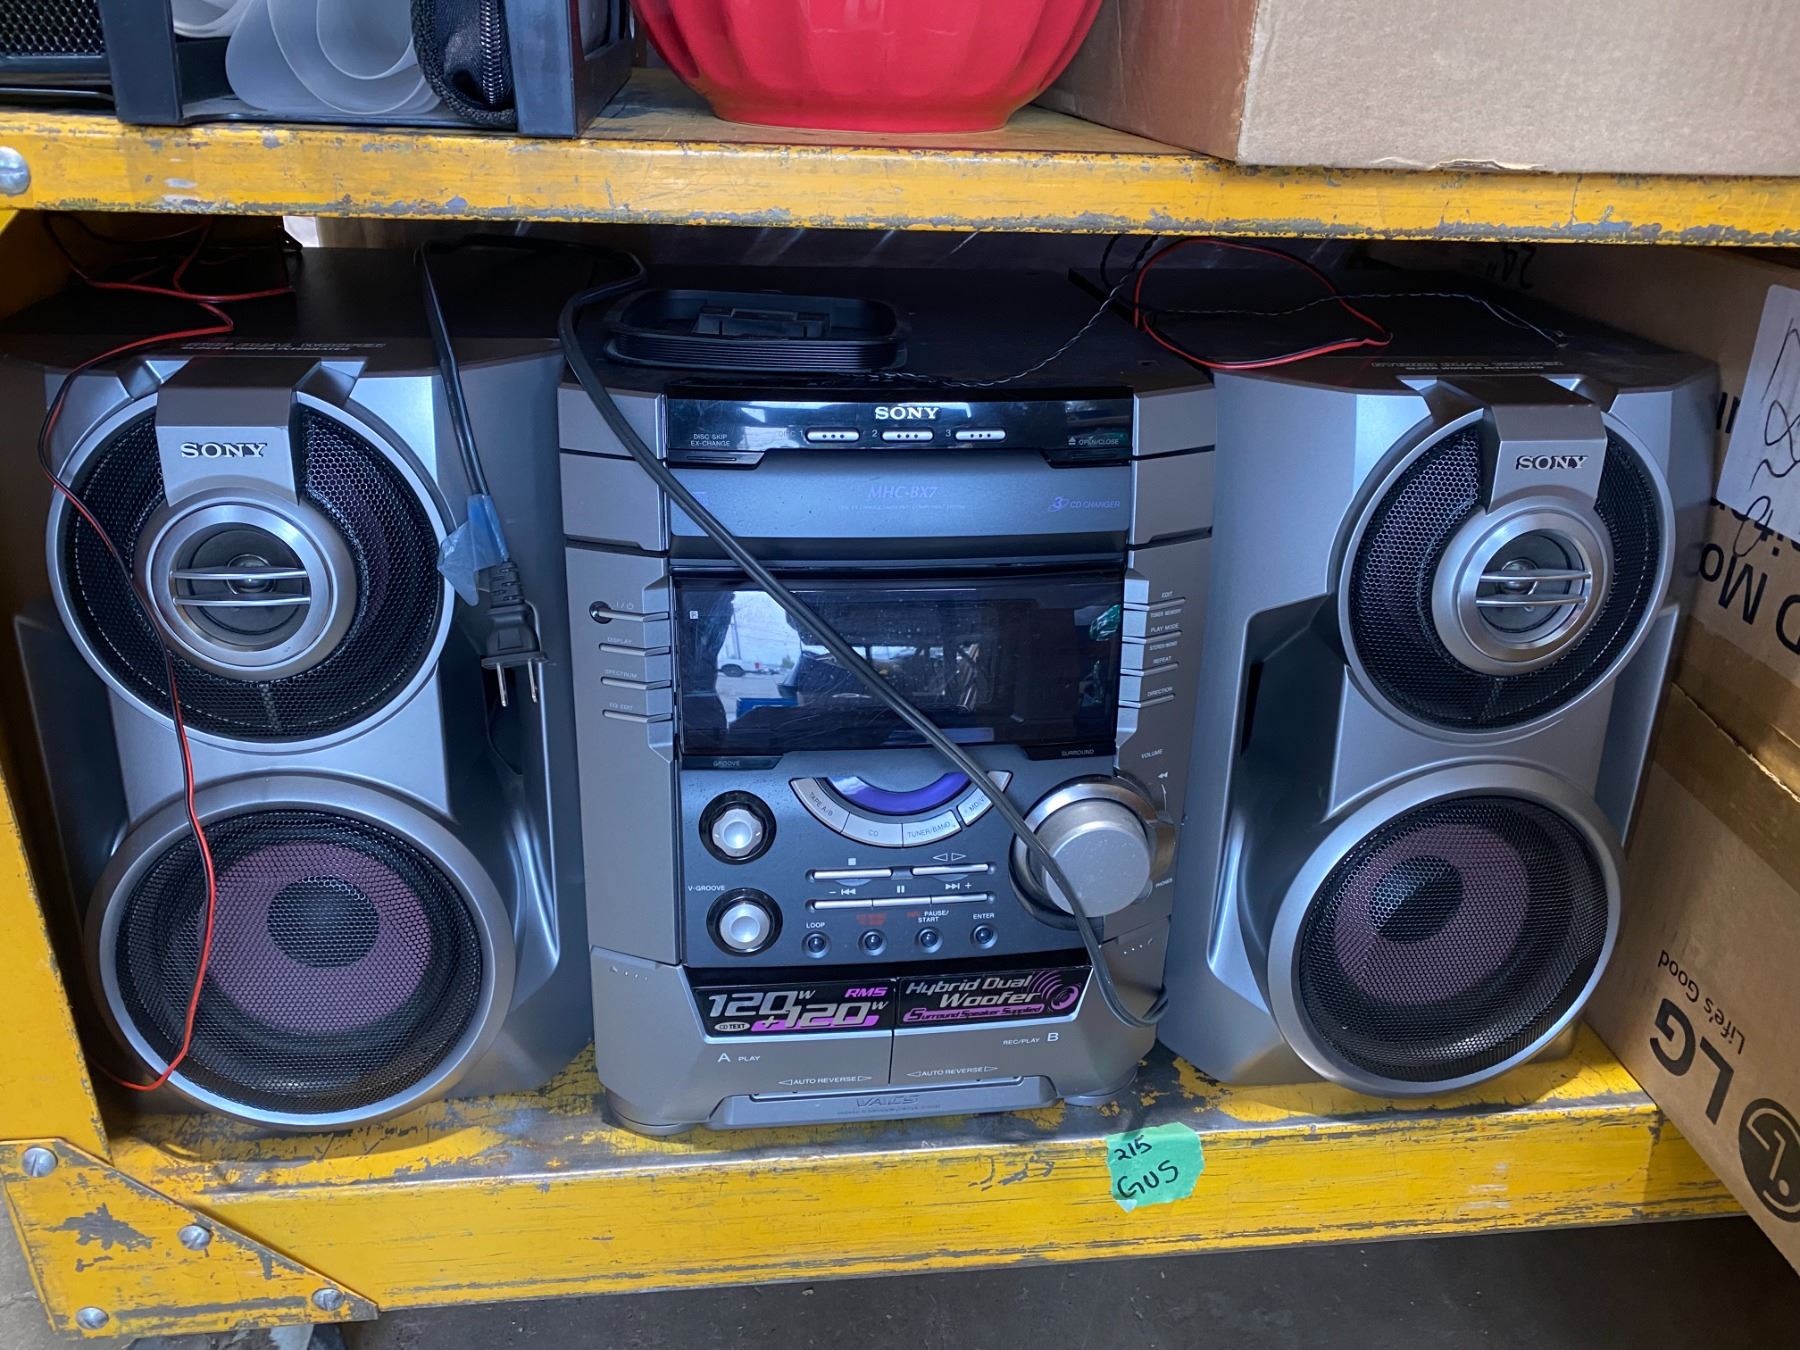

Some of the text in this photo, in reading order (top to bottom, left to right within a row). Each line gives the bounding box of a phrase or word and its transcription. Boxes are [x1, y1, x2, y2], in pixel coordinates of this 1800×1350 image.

[874, 407, 939, 420] SONY
[872, 429, 878, 437] 2
[945, 429, 951, 437] 3
[180, 442, 267, 460] SONY
[1516, 456, 1588, 470] SONY
[868, 485, 938, 499] MHC-BX7
[1070, 501, 1081, 509] CD
[1082, 500, 1120, 509] CHANGER
[1141, 748, 1164, 759] VOLUME
[809, 791, 822, 807] TAPE
[868, 829, 879, 837] CD
[907, 821, 951, 839] TUNER/BAND
[918, 916, 940, 924] START
[924, 910, 949, 918] PAUSE/
[973, 912, 995, 920] ENTER
[905, 974, 1033, 996] Hybrid Dual
[844, 986, 889, 998] RMS
[939, 990, 1041, 1008] Woofer
[1657, 950, 1746, 1056] Life's Good
[908, 1005, 1043, 1021] Surround Speaker Supplied
[1003, 1032, 1059, 1045] REC/PLAY B
[718, 1053, 731, 1063] A
[1650, 998, 1734, 1125] LG
[945, 1067, 983, 1075] REVERSE
[793, 1075, 858, 1085] AUTO REVERSE
[1113, 1134, 1152, 1160] 215
[1117, 1160, 1178, 1198] GUS
